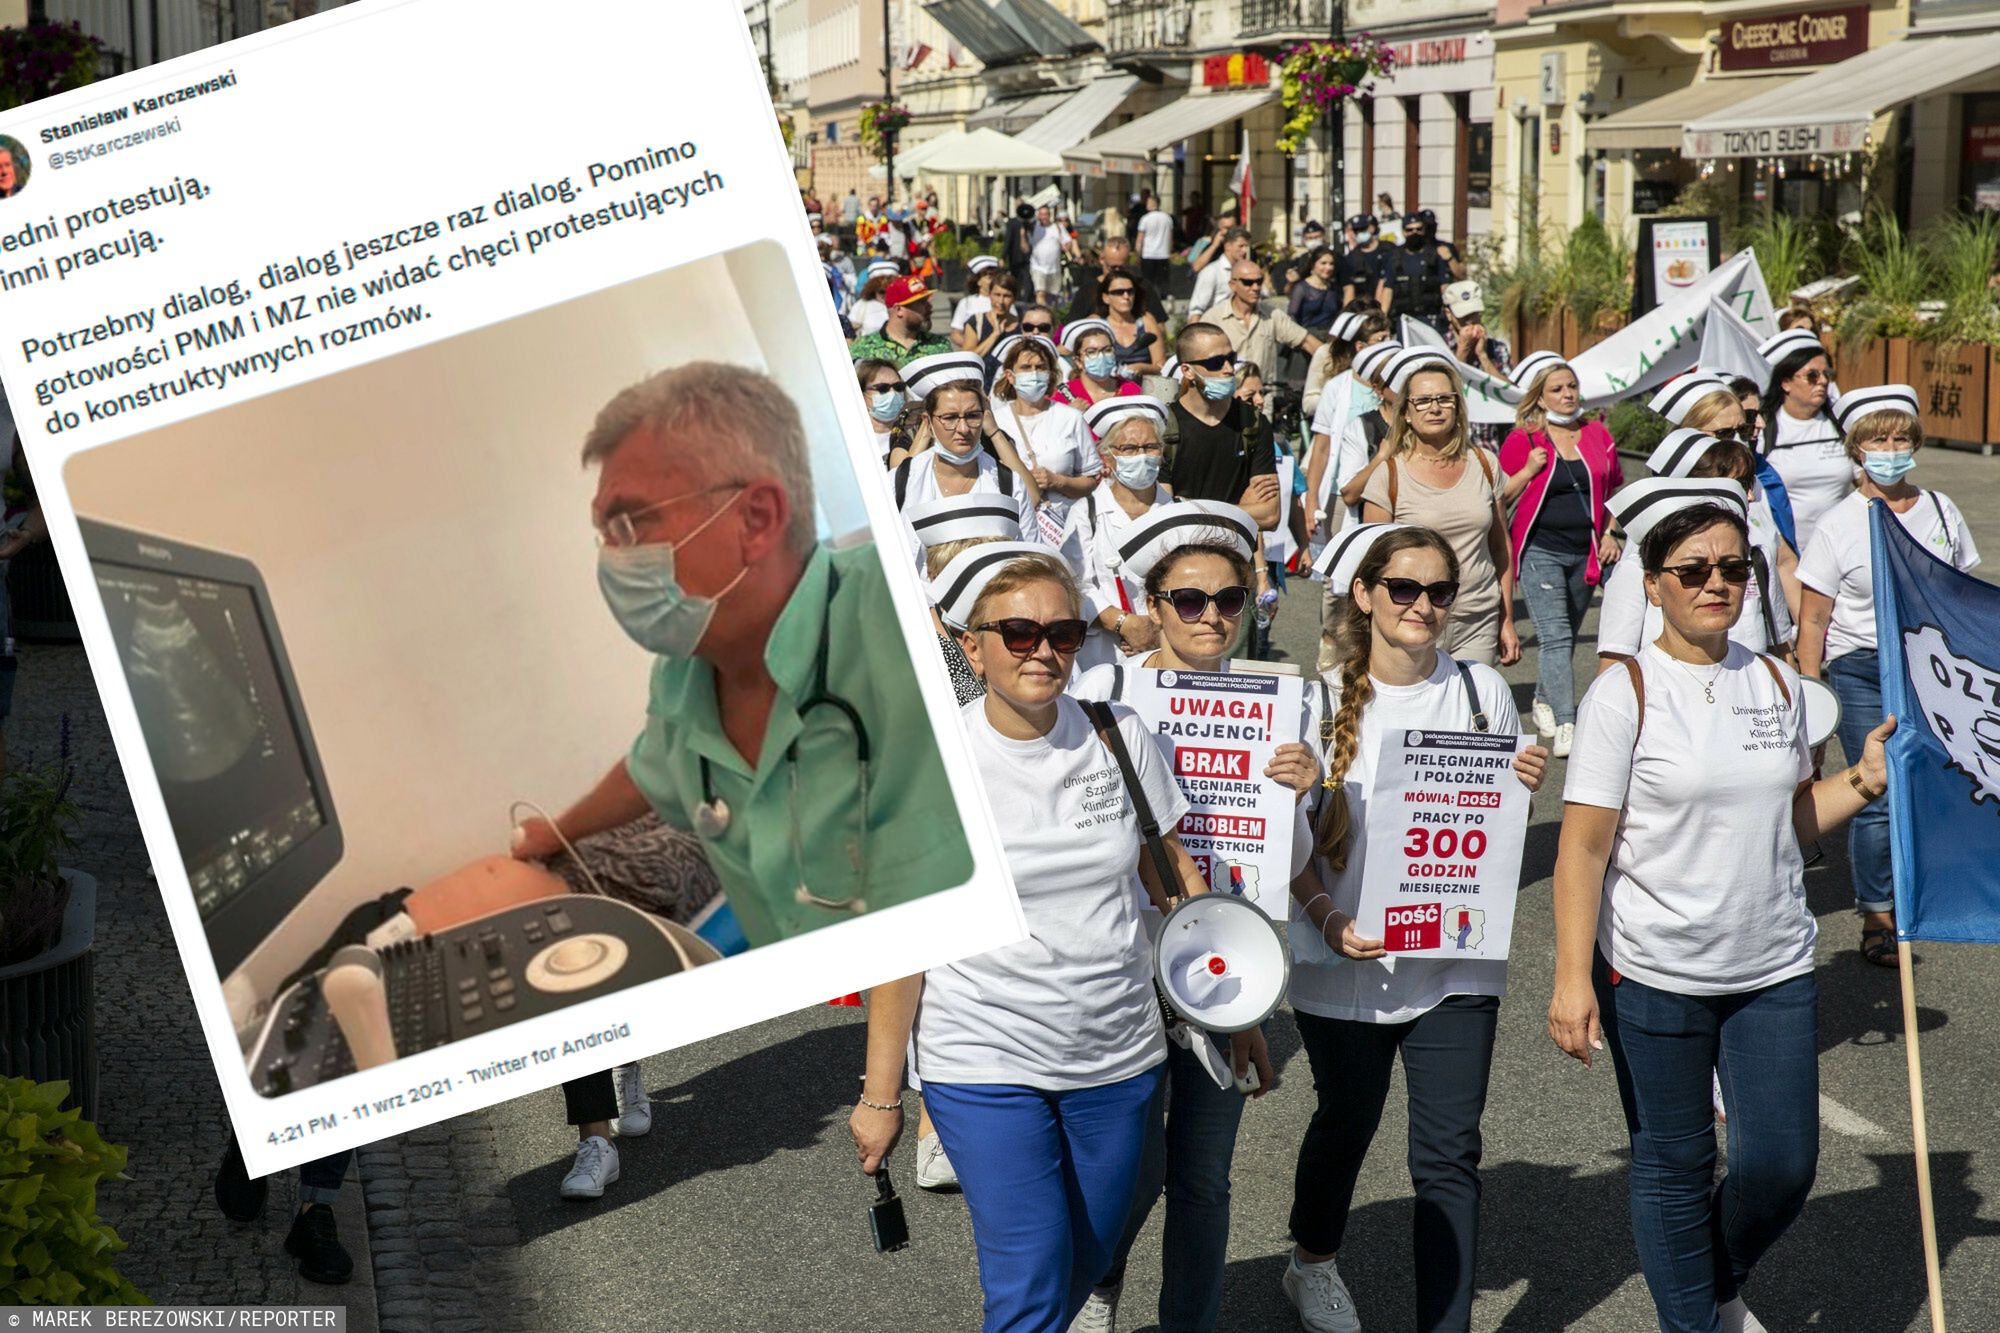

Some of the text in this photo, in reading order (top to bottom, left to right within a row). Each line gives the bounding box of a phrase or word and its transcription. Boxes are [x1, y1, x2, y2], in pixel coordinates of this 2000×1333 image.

[1799, 14, 1847, 43] CORNER
[1723, 131, 1770, 153] TOKYO
[1777, 128, 1821, 151] SUSHI
[1179, 674, 1218, 682] OGÓLNOPOLSKI
[1170, 697, 1263, 720] UWAGA
[1158, 721, 1263, 741] PACJENCI
[1425, 733, 1461, 741] OGÓLNOPOLSKI
[1181, 751, 1243, 776] BRAK
[1404, 754, 1510, 769] PIELĘGNIARKI
[1414, 770, 1495, 784] I POŁOŻNE
[1085, 779, 1120, 798] Szpital
[1176, 779, 1262, 795] ELĘGNIAREK
[1404, 790, 1499, 806] MÓWIĄ: DOŚĆ
[1075, 820, 1092, 830] we
[1183, 815, 1262, 837] PROBLEM
[1412, 812, 1485, 824] PRACY PO
[1181, 838, 1264, 854] WSZYSTKICH
[1403, 827, 1487, 860] 300
[1407, 863, 1477, 878] GODZIN
[1400, 883, 1480, 894] MIESIĘCZNIE
[1388, 904, 1439, 926] DOŚĆ
[1404, 929, 1421, 949] !!!
